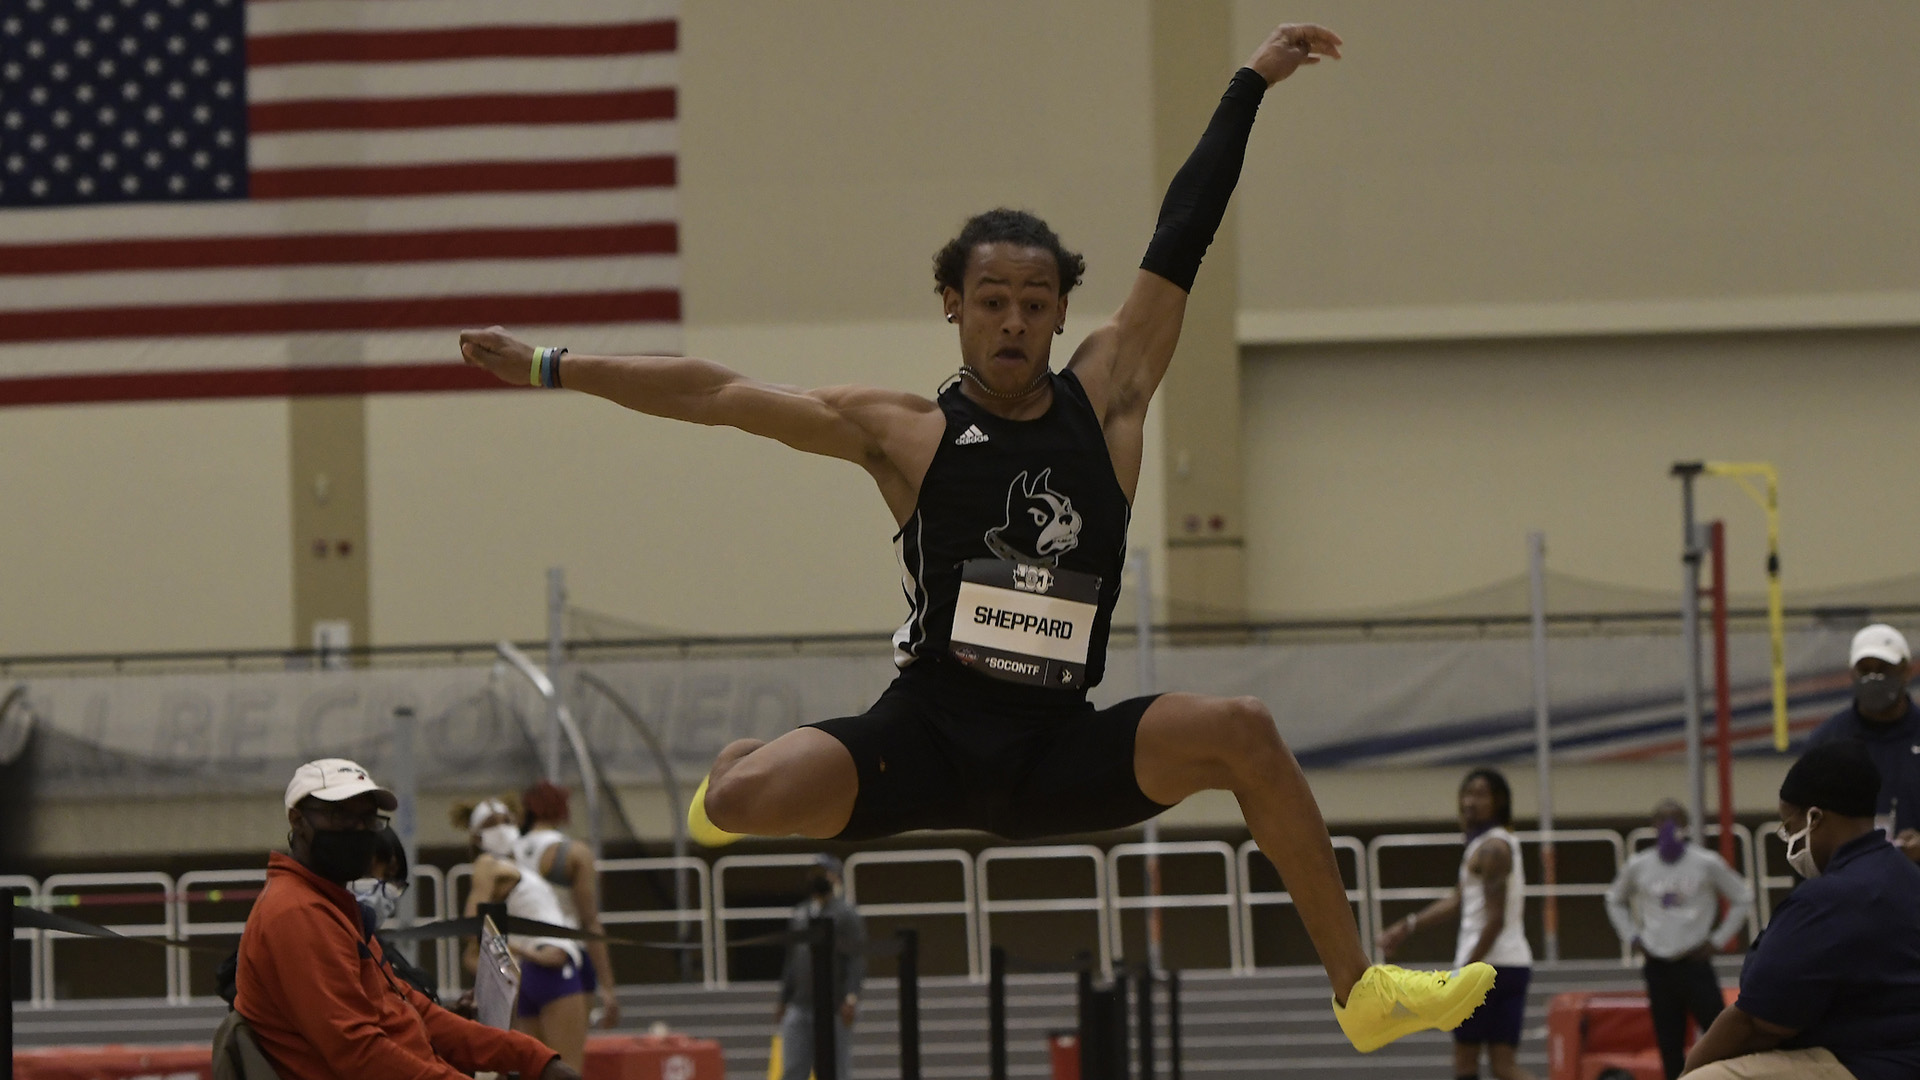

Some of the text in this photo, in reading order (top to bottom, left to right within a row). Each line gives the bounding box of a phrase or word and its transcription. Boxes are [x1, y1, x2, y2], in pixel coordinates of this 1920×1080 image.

[955, 434, 989, 445] adidas
[973, 605, 1074, 640] SHEPPARD
[985, 657, 1041, 676] #SOCONTF
